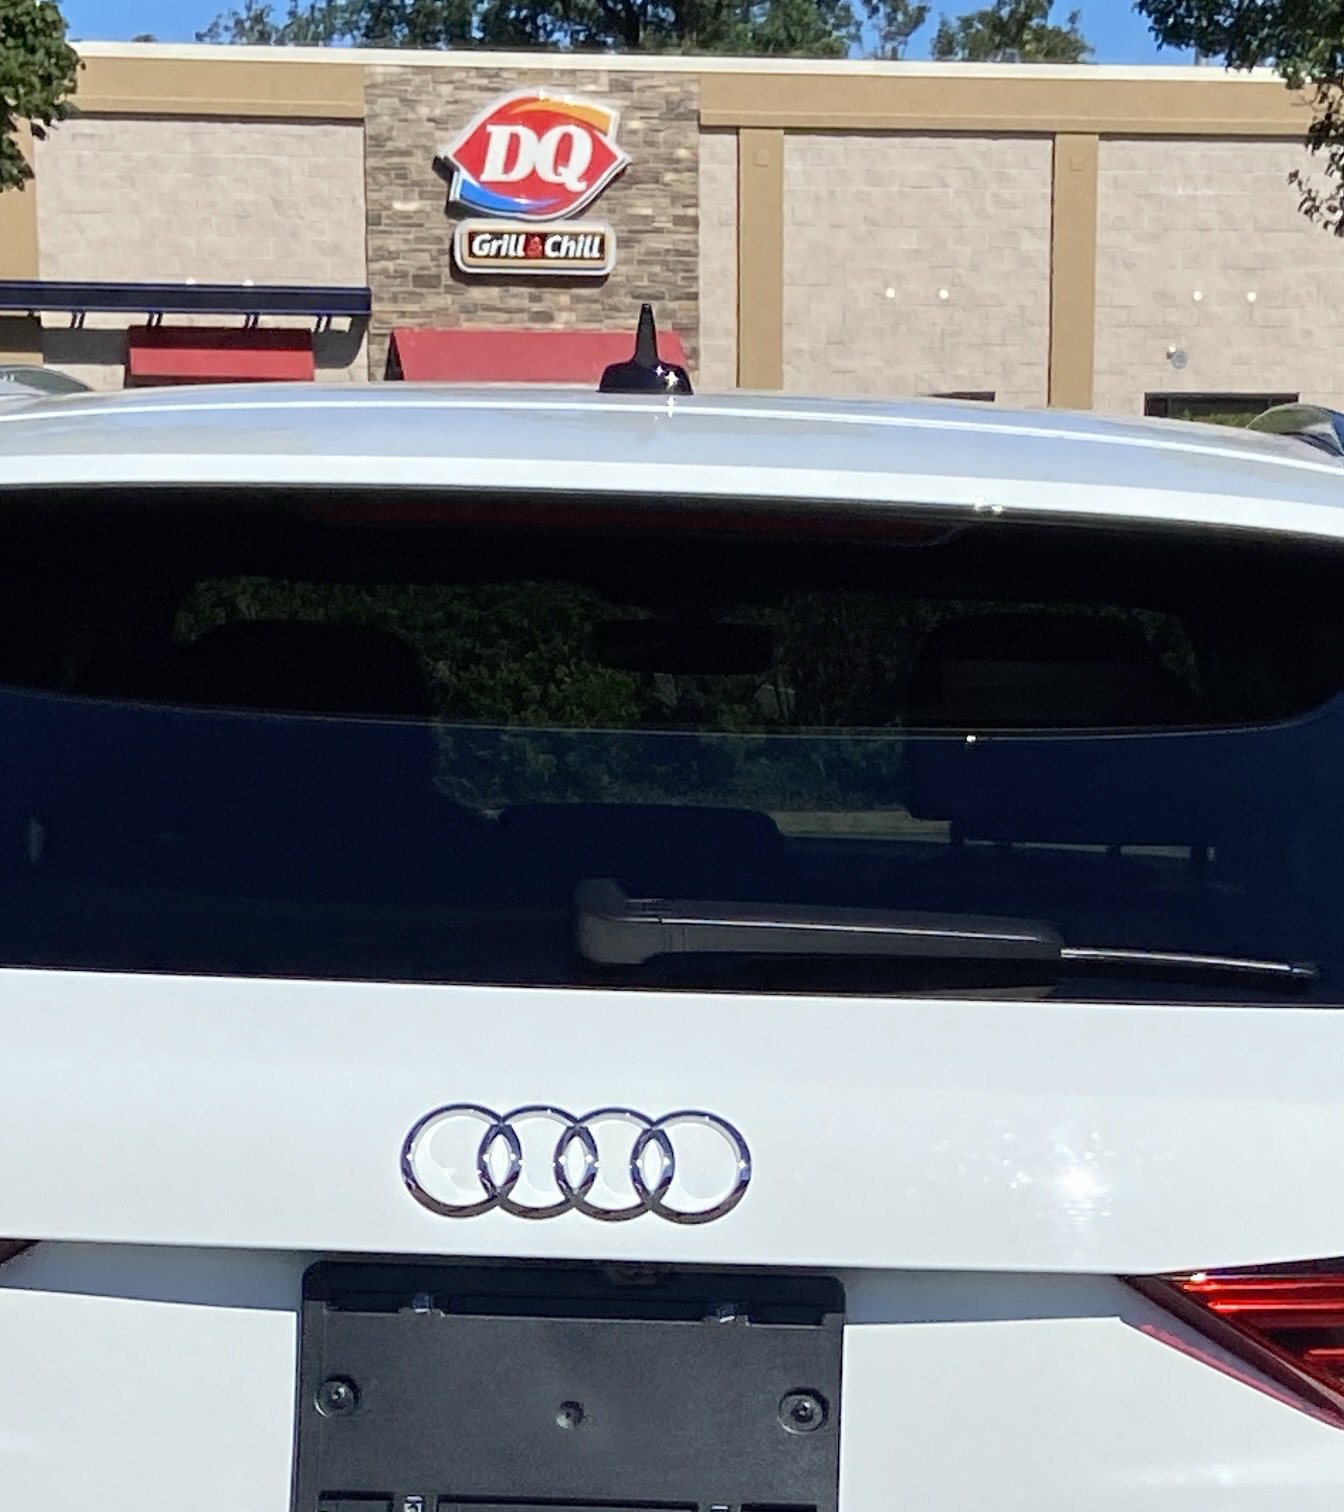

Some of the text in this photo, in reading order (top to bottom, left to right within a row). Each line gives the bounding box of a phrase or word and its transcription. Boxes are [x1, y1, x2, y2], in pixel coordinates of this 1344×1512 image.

[479, 123, 594, 192] DQ
[471, 233, 526, 258] Grill
[544, 232, 602, 259] Chill
